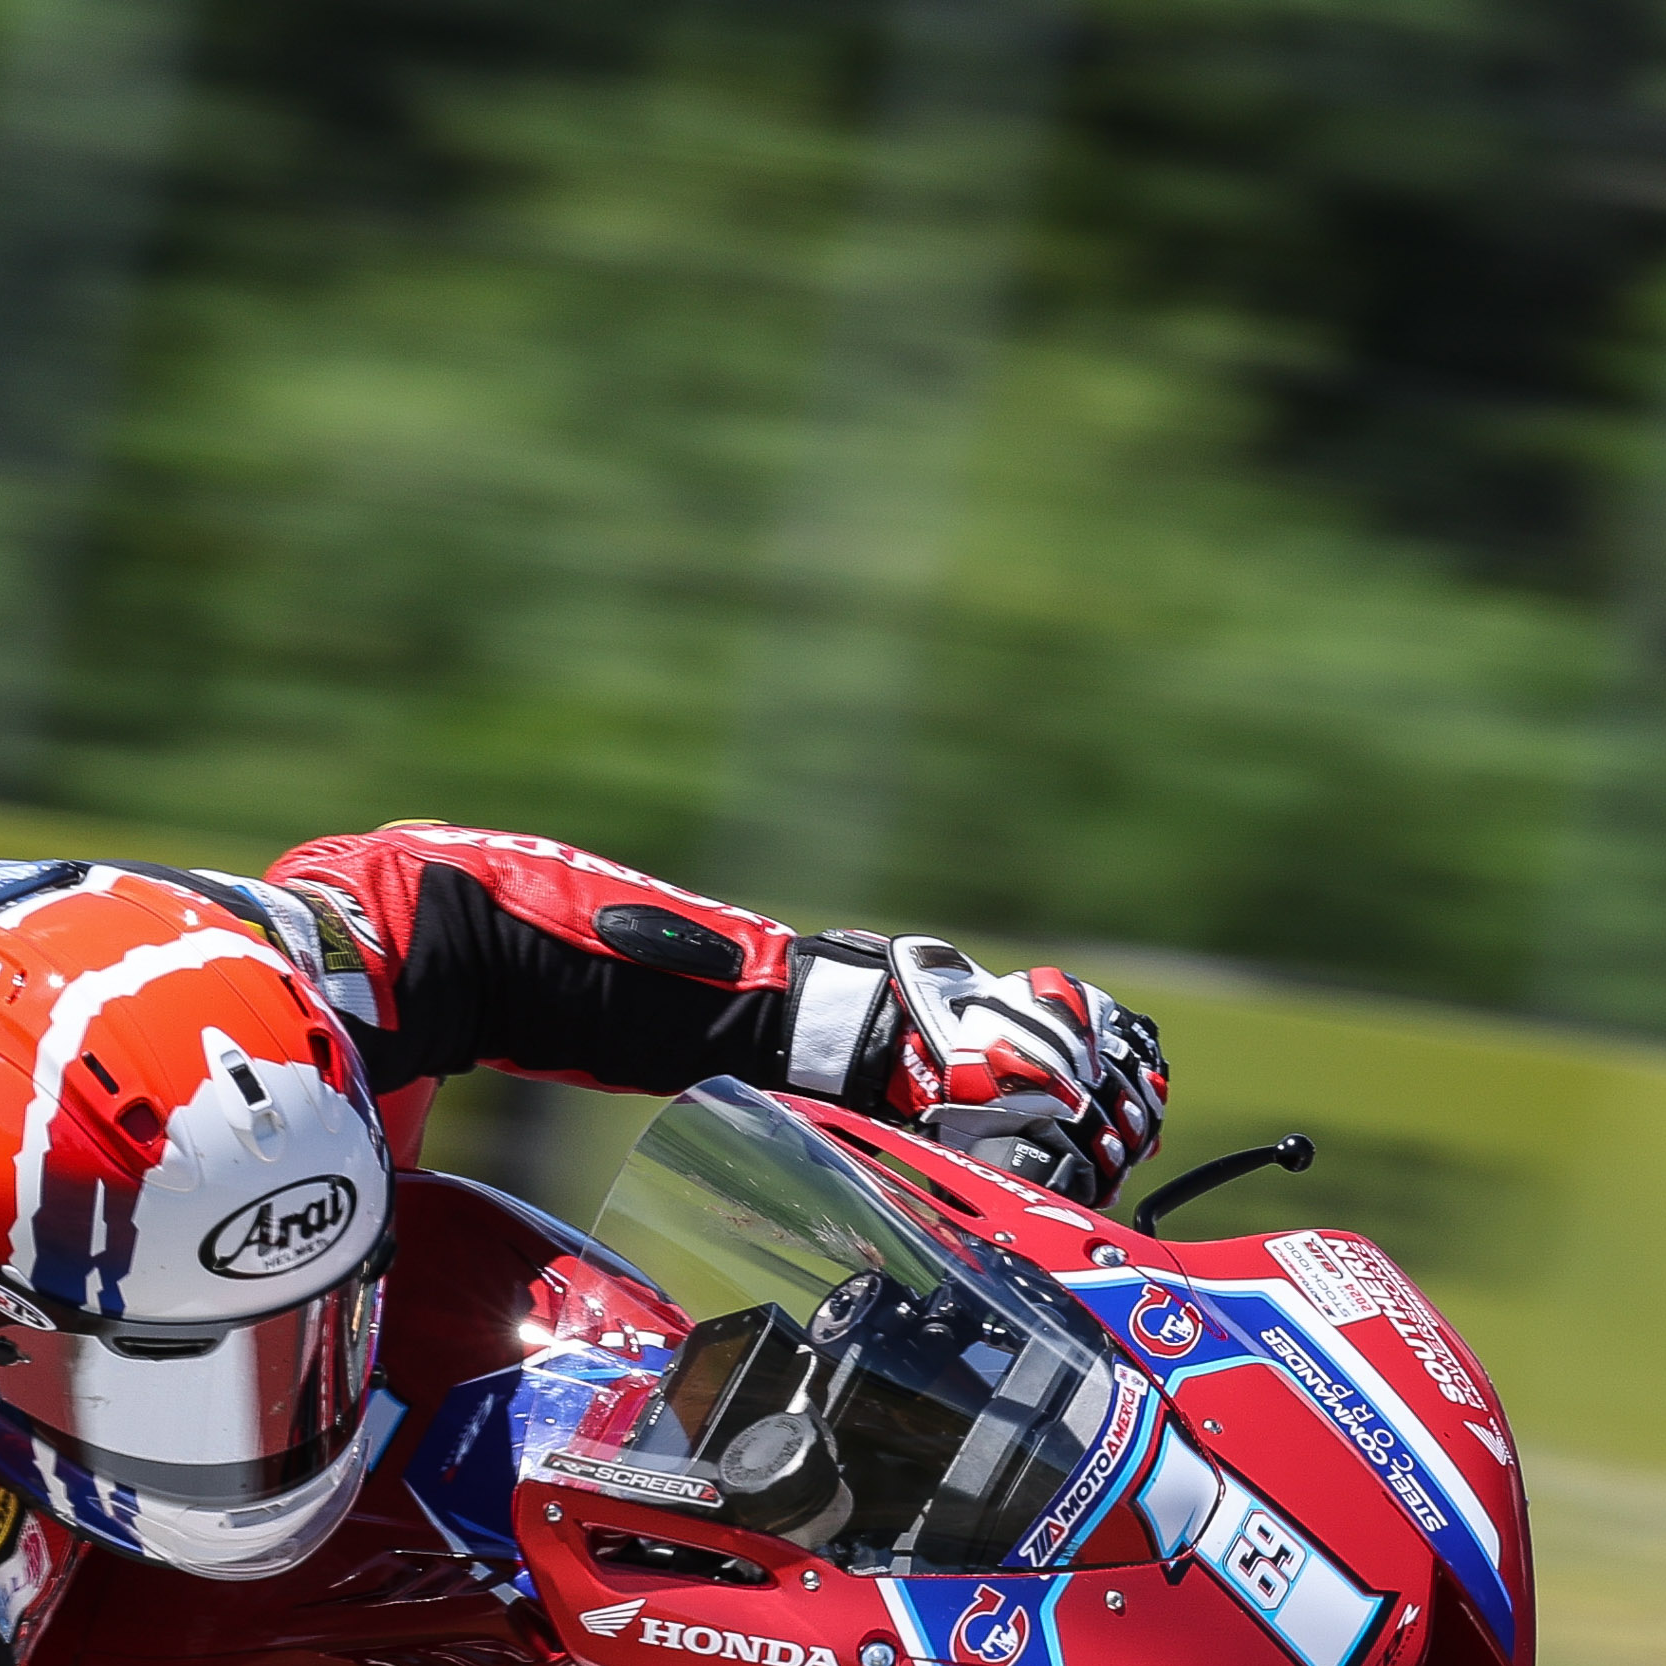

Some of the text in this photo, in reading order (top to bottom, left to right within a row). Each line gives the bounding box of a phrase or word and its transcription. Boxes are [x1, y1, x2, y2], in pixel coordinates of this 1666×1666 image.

[213, 1177, 343, 1269] Arai
[1283, 1240, 1314, 1273] 1000
[1312, 1272, 1350, 1319] STOCK
[1324, 1238, 1466, 1406] SOUTHERN
[1344, 1284, 1371, 1312] 2024
[1261, 1326, 1389, 1466] COMMANDER
[1331, 1383, 1415, 1474] CORP
[1383, 1460, 1447, 1534] STEEL
